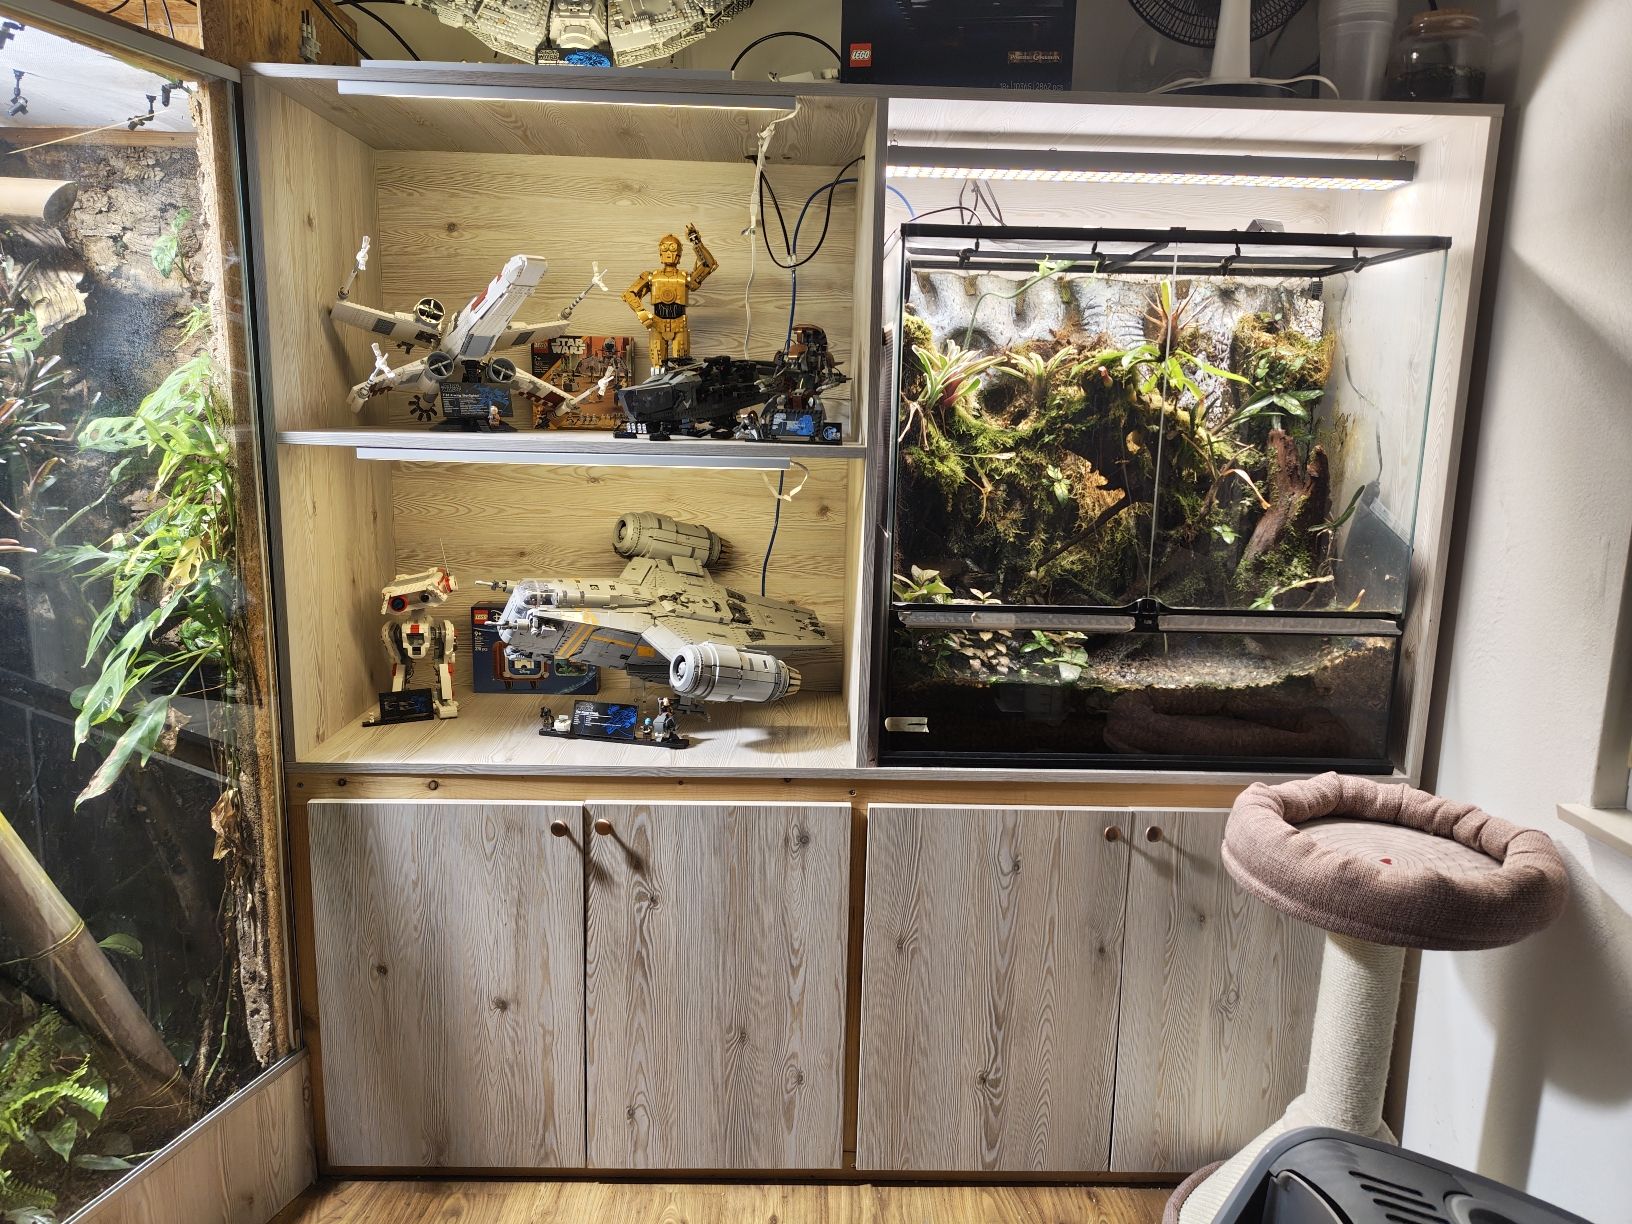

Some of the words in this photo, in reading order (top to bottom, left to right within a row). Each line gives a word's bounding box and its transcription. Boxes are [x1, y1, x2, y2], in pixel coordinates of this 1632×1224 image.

[851, 50, 870, 60] LEGO
[551, 337, 586, 346] STAR
[551, 345, 586, 355] WARS
